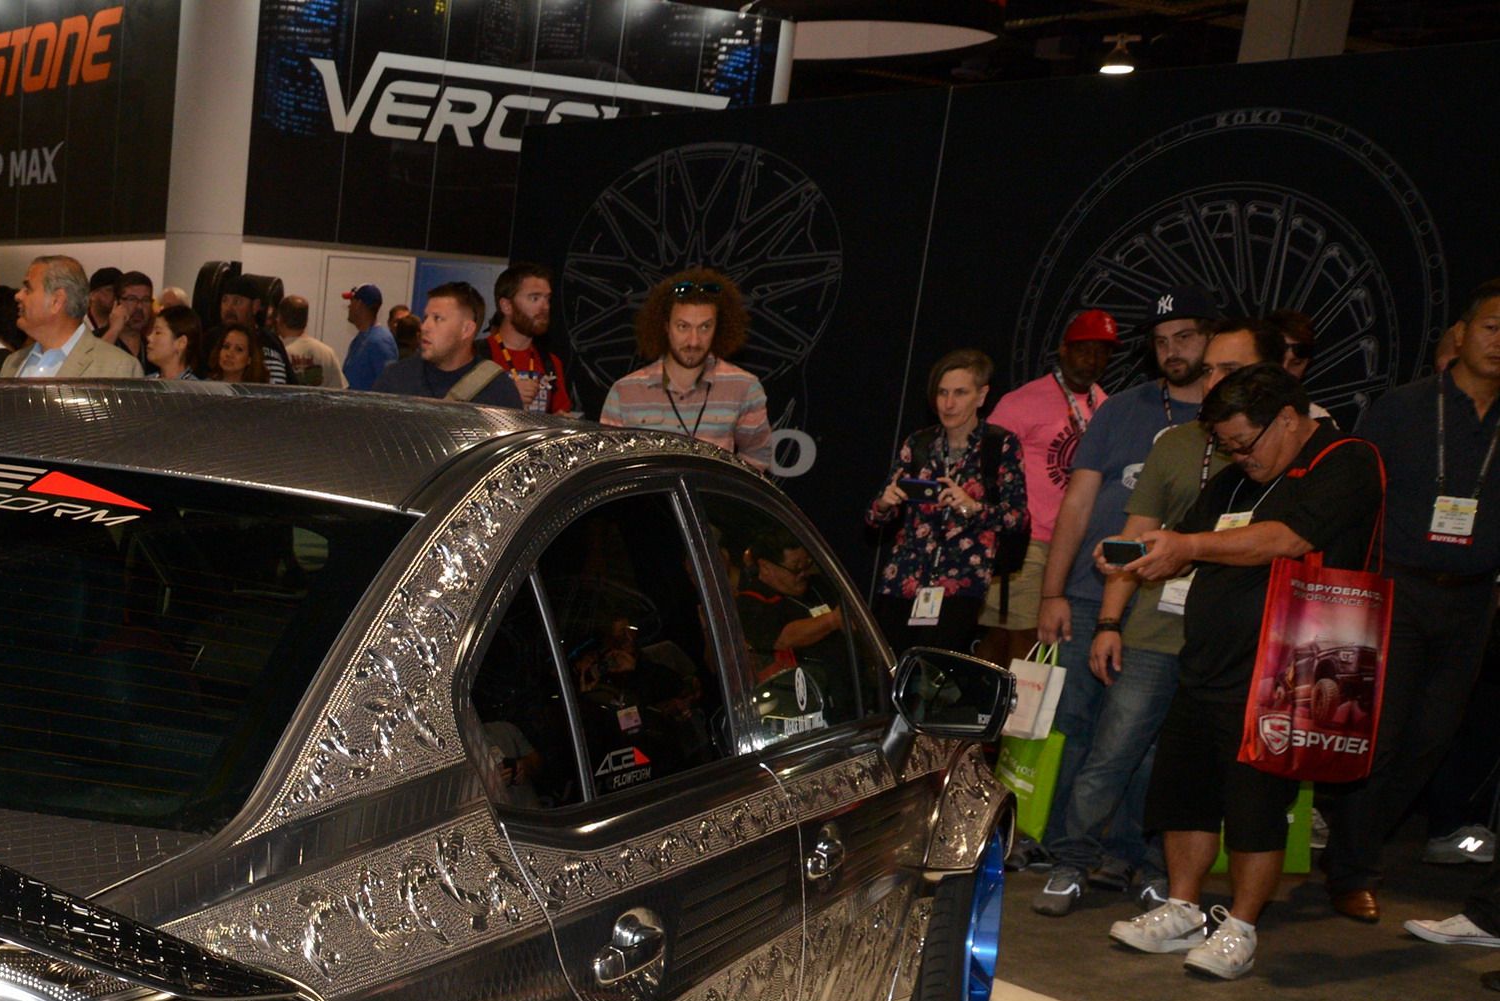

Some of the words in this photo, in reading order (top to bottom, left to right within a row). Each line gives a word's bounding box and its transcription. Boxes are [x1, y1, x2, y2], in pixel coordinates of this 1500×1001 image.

[1216, 110, 1282, 128] KOKO
[9, 141, 65, 187] MAX
[612, 767, 651, 789] FLOWFORM
